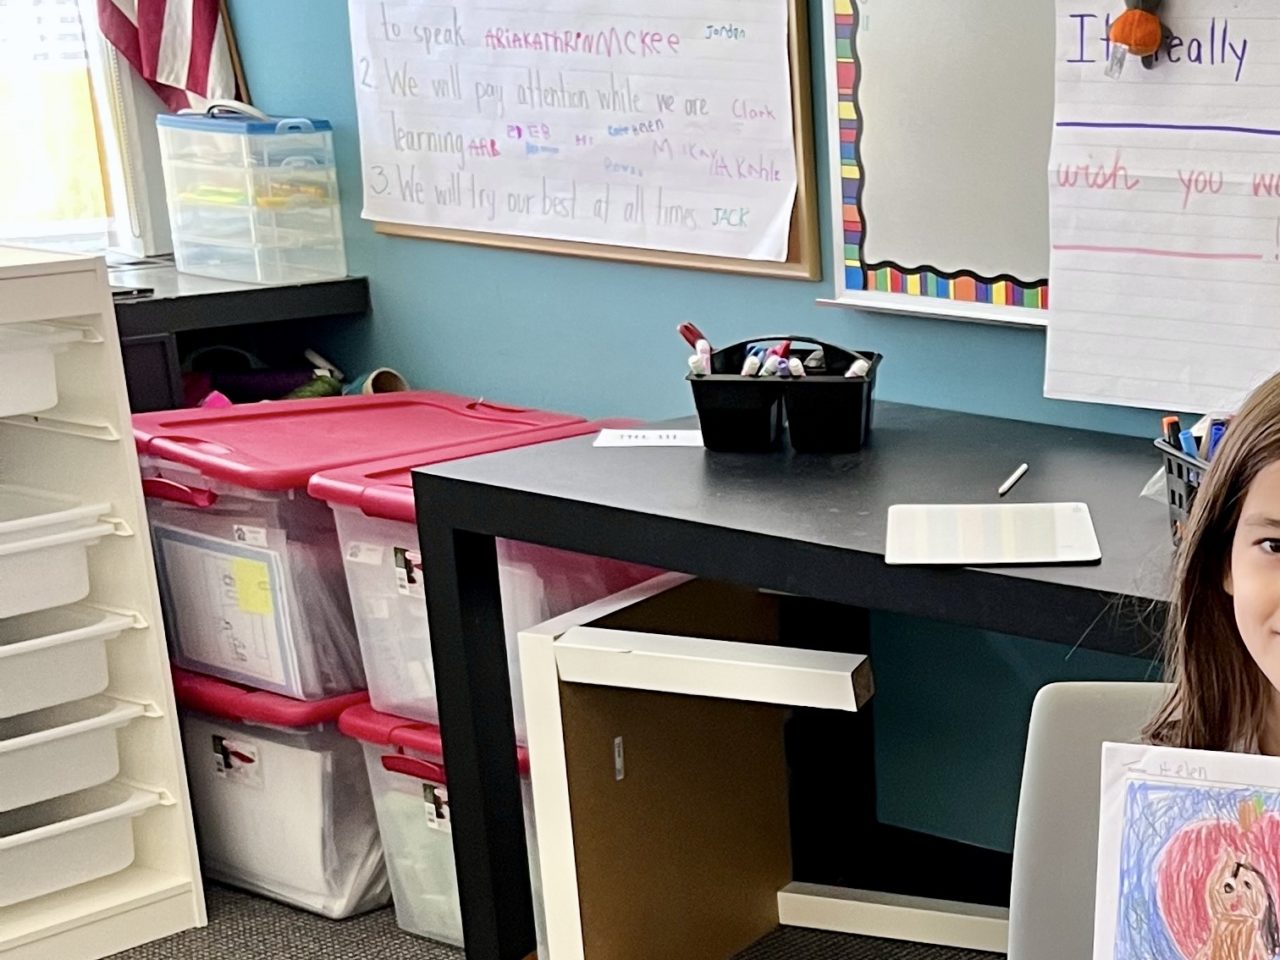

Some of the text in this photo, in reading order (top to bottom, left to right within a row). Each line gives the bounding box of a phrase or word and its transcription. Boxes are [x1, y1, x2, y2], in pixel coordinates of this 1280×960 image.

[380, 0, 401, 42] to
[412, 6, 465, 55] speak
[384, 57, 418, 97] We
[432, 62, 462, 101] will
[474, 83, 505, 119] pay
[517, 67, 590, 111] attention
[597, 71, 642, 114] while
[685, 96, 710, 117] are
[390, 109, 465, 171] learning
[370, 165, 392, 195] 3.
[396, 164, 425, 206] We
[434, 172, 462, 208] will
[471, 173, 496, 222] try
[507, 190, 535, 218] our
[541, 175, 576, 220] best
[593, 183, 611, 224] at
[624, 184, 645, 223] all
[1056, 149, 1140, 190] wish
[1176, 166, 1224, 210] you
[711, 207, 749, 227] JACK
[1158, 761, 1208, 780] Helen
